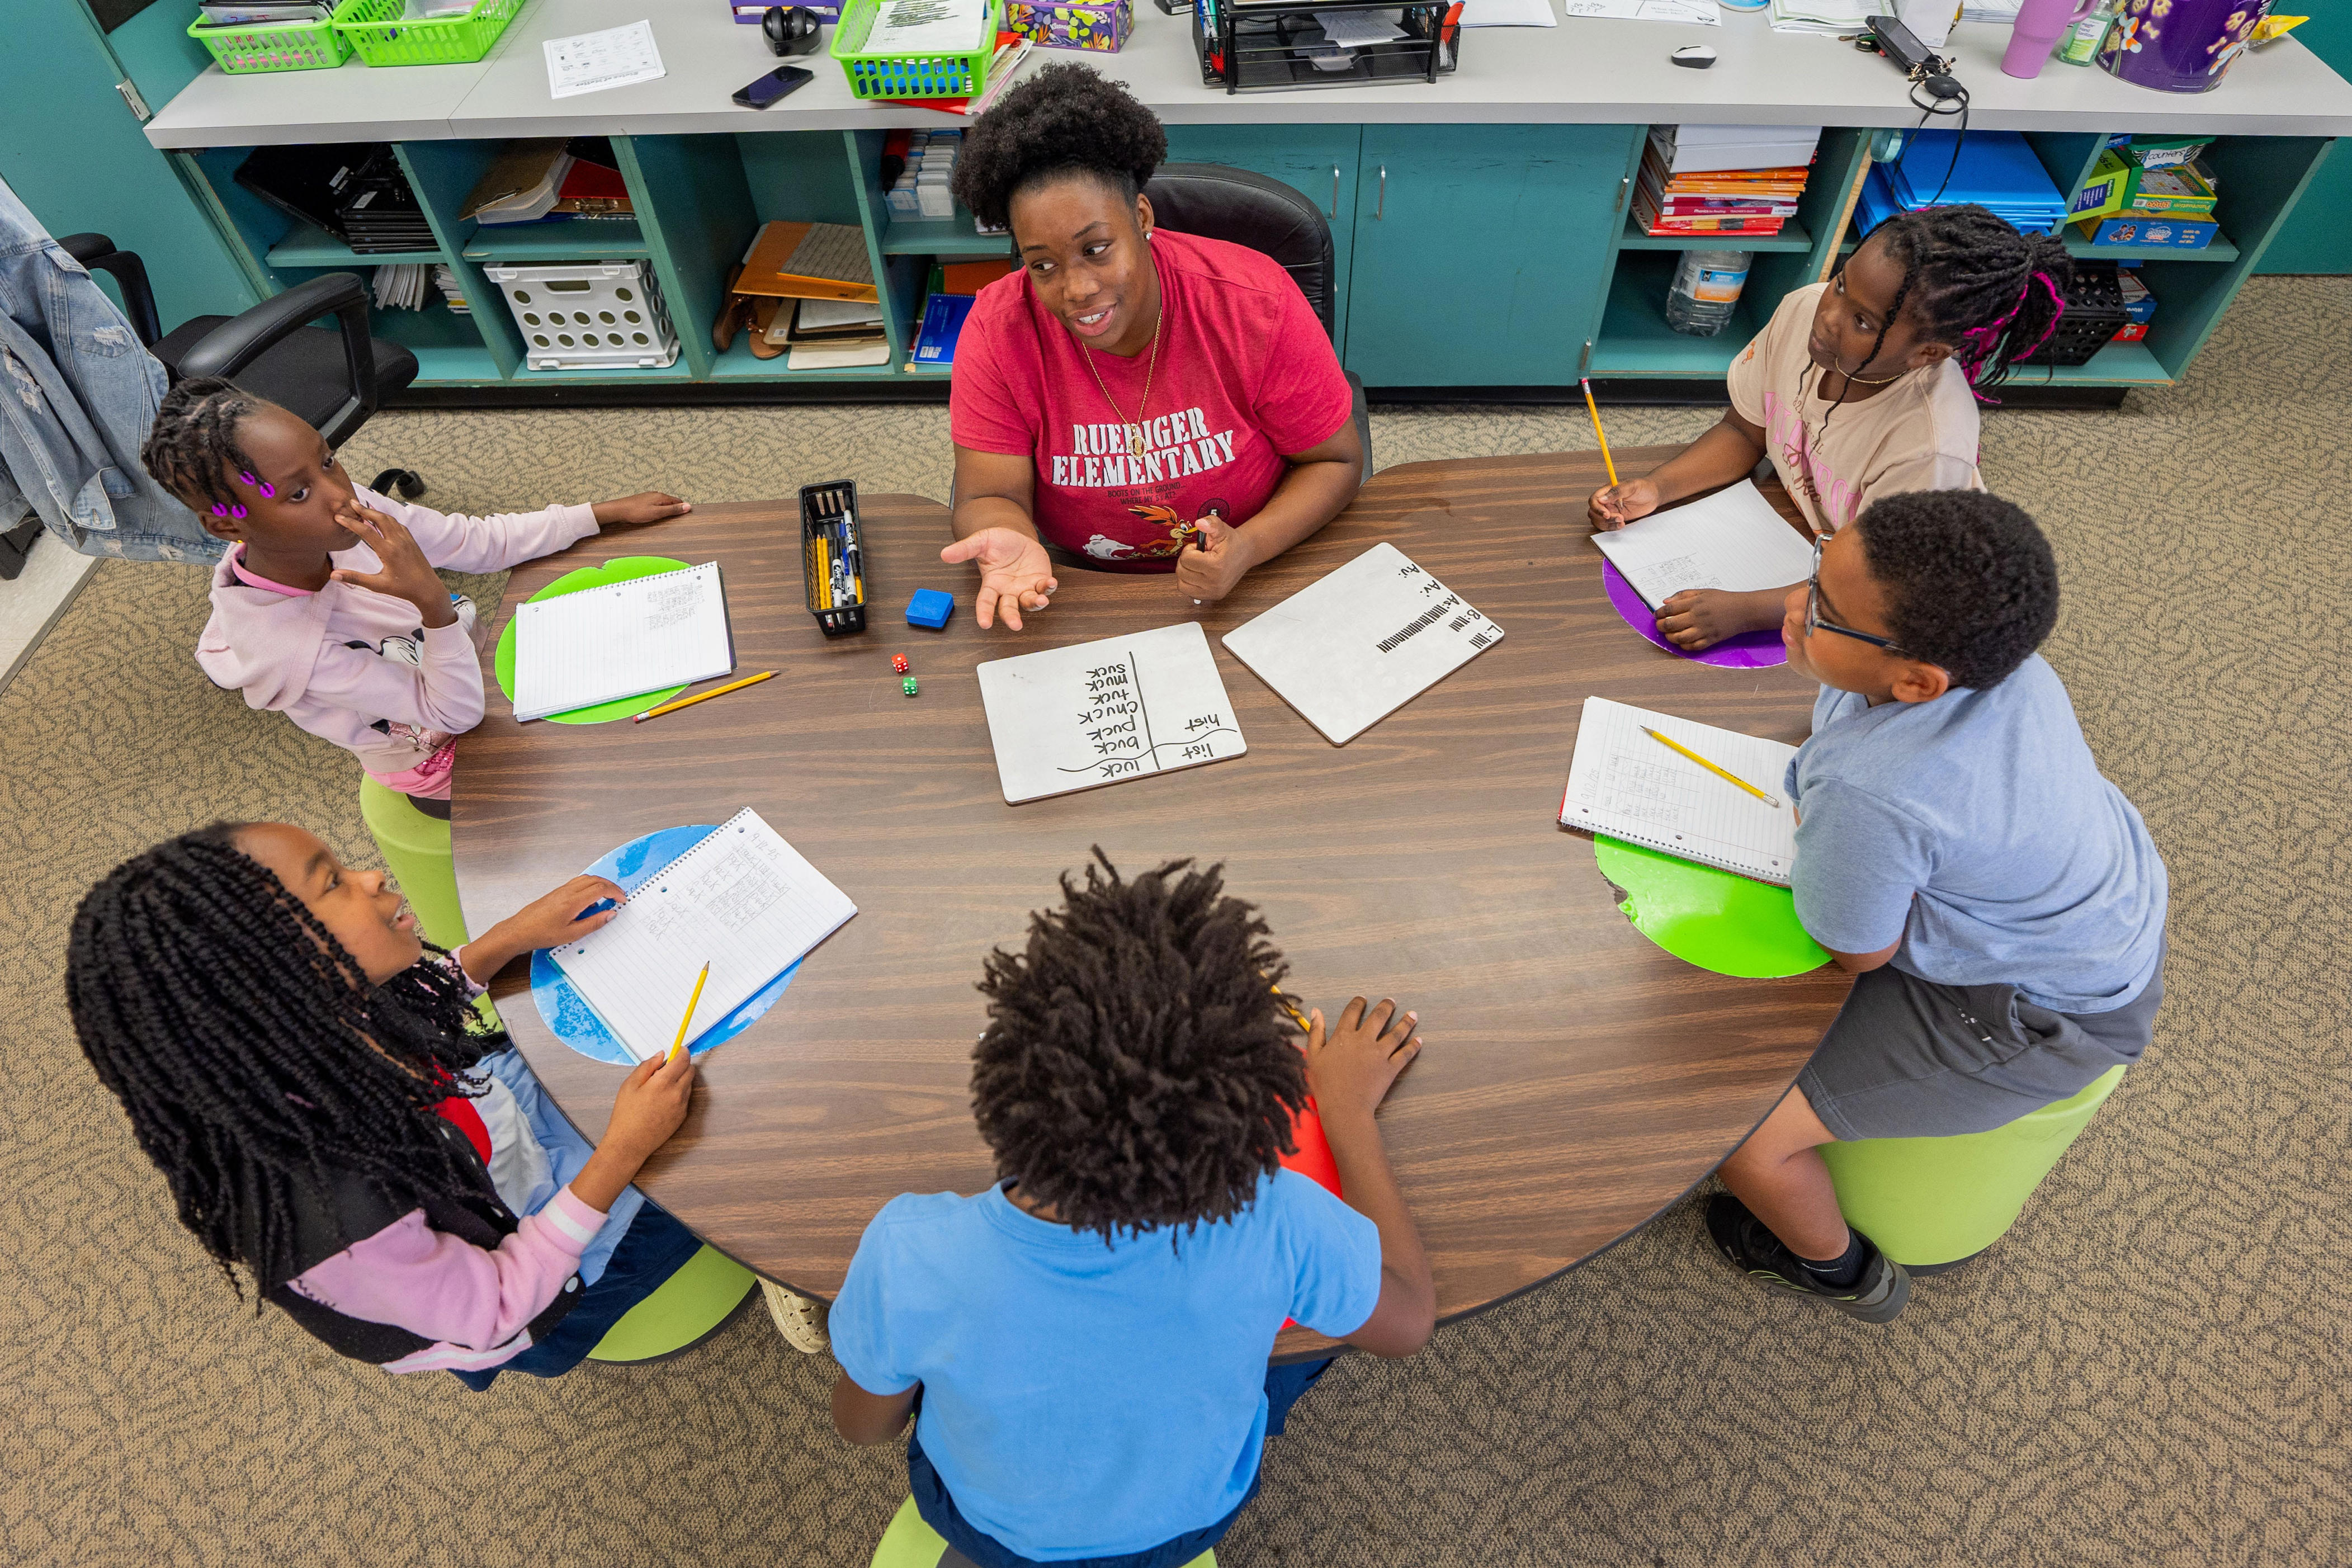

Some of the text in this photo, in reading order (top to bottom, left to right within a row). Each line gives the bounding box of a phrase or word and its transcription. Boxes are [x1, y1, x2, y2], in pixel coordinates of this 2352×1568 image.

[1052, 429, 1236, 488] ELEMENTARY
[1108, 488, 1129, 498] BOOTS
[1130, 488, 1140, 497] ON
[1141, 485, 1154, 495] THE
[1120, 496, 1142, 505] WHERE
[1086, 664, 1126, 678] suck
[1085, 673, 1128, 691] muck
[1089, 689, 1130, 705] tuck
[1078, 701, 1139, 725] chuck
[1087, 714, 1136, 740] puck
[1184, 714, 1220, 731] hist
[1094, 736, 1139, 754] buck
[1182, 743, 1214, 759] list
[1099, 760, 1140, 777] luck
